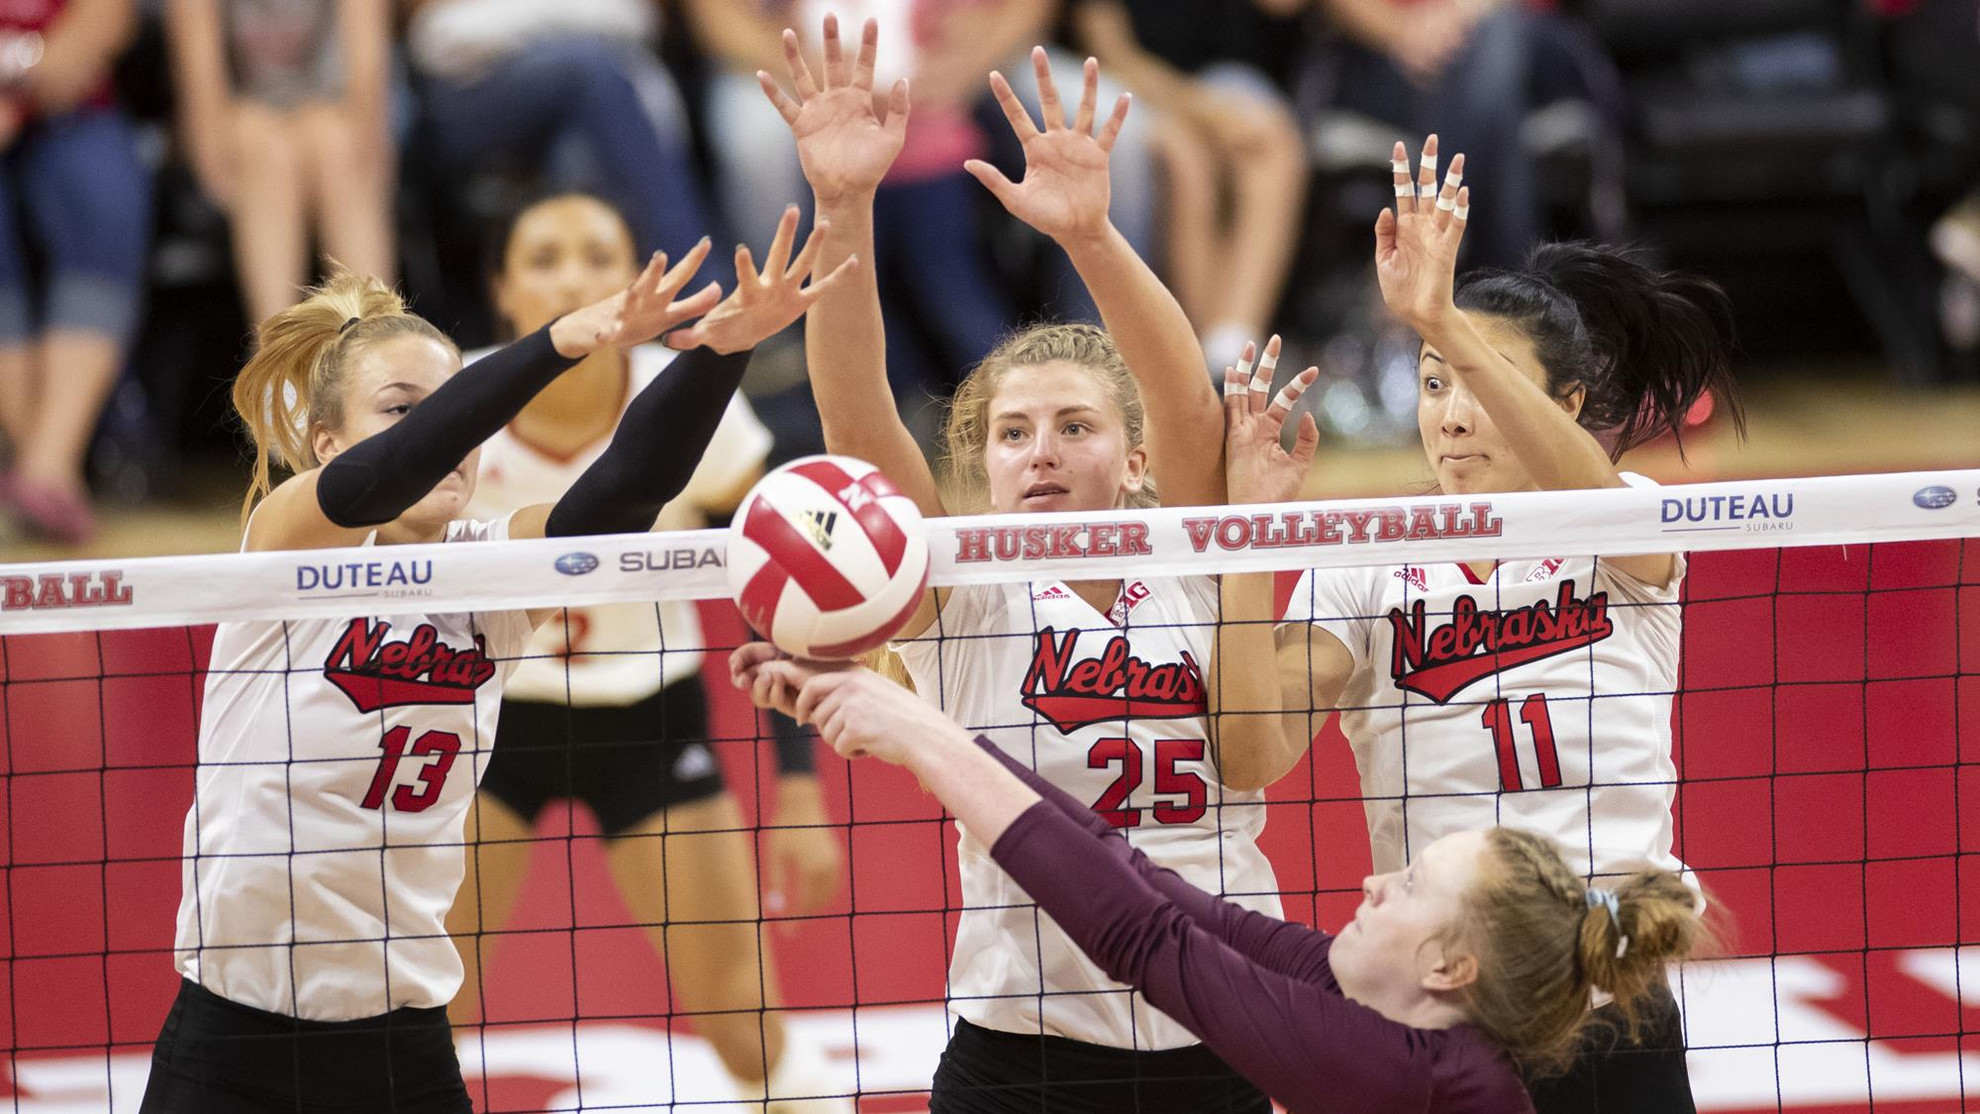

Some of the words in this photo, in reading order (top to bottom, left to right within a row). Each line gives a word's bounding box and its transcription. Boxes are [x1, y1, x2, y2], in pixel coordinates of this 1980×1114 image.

[955, 520, 1152, 563] HUSKER
[1182, 502, 1503, 553] VOLLEYBALL
[1661, 493, 1793, 523] DUTEAU
[1745, 522, 1794, 532] SUBARU
[297, 560, 432, 591] DUTEAU
[619, 547, 727, 573] SUBA
[0, 570, 133, 612] BALL
[383, 588, 433, 599] SUBARU
[1388, 579, 1613, 682] Nebraska
[1020, 625, 1205, 704] Nebras
[1481, 692, 1563, 793] 11
[360, 725, 462, 813] 13
[1087, 737, 1208, 828] 25
